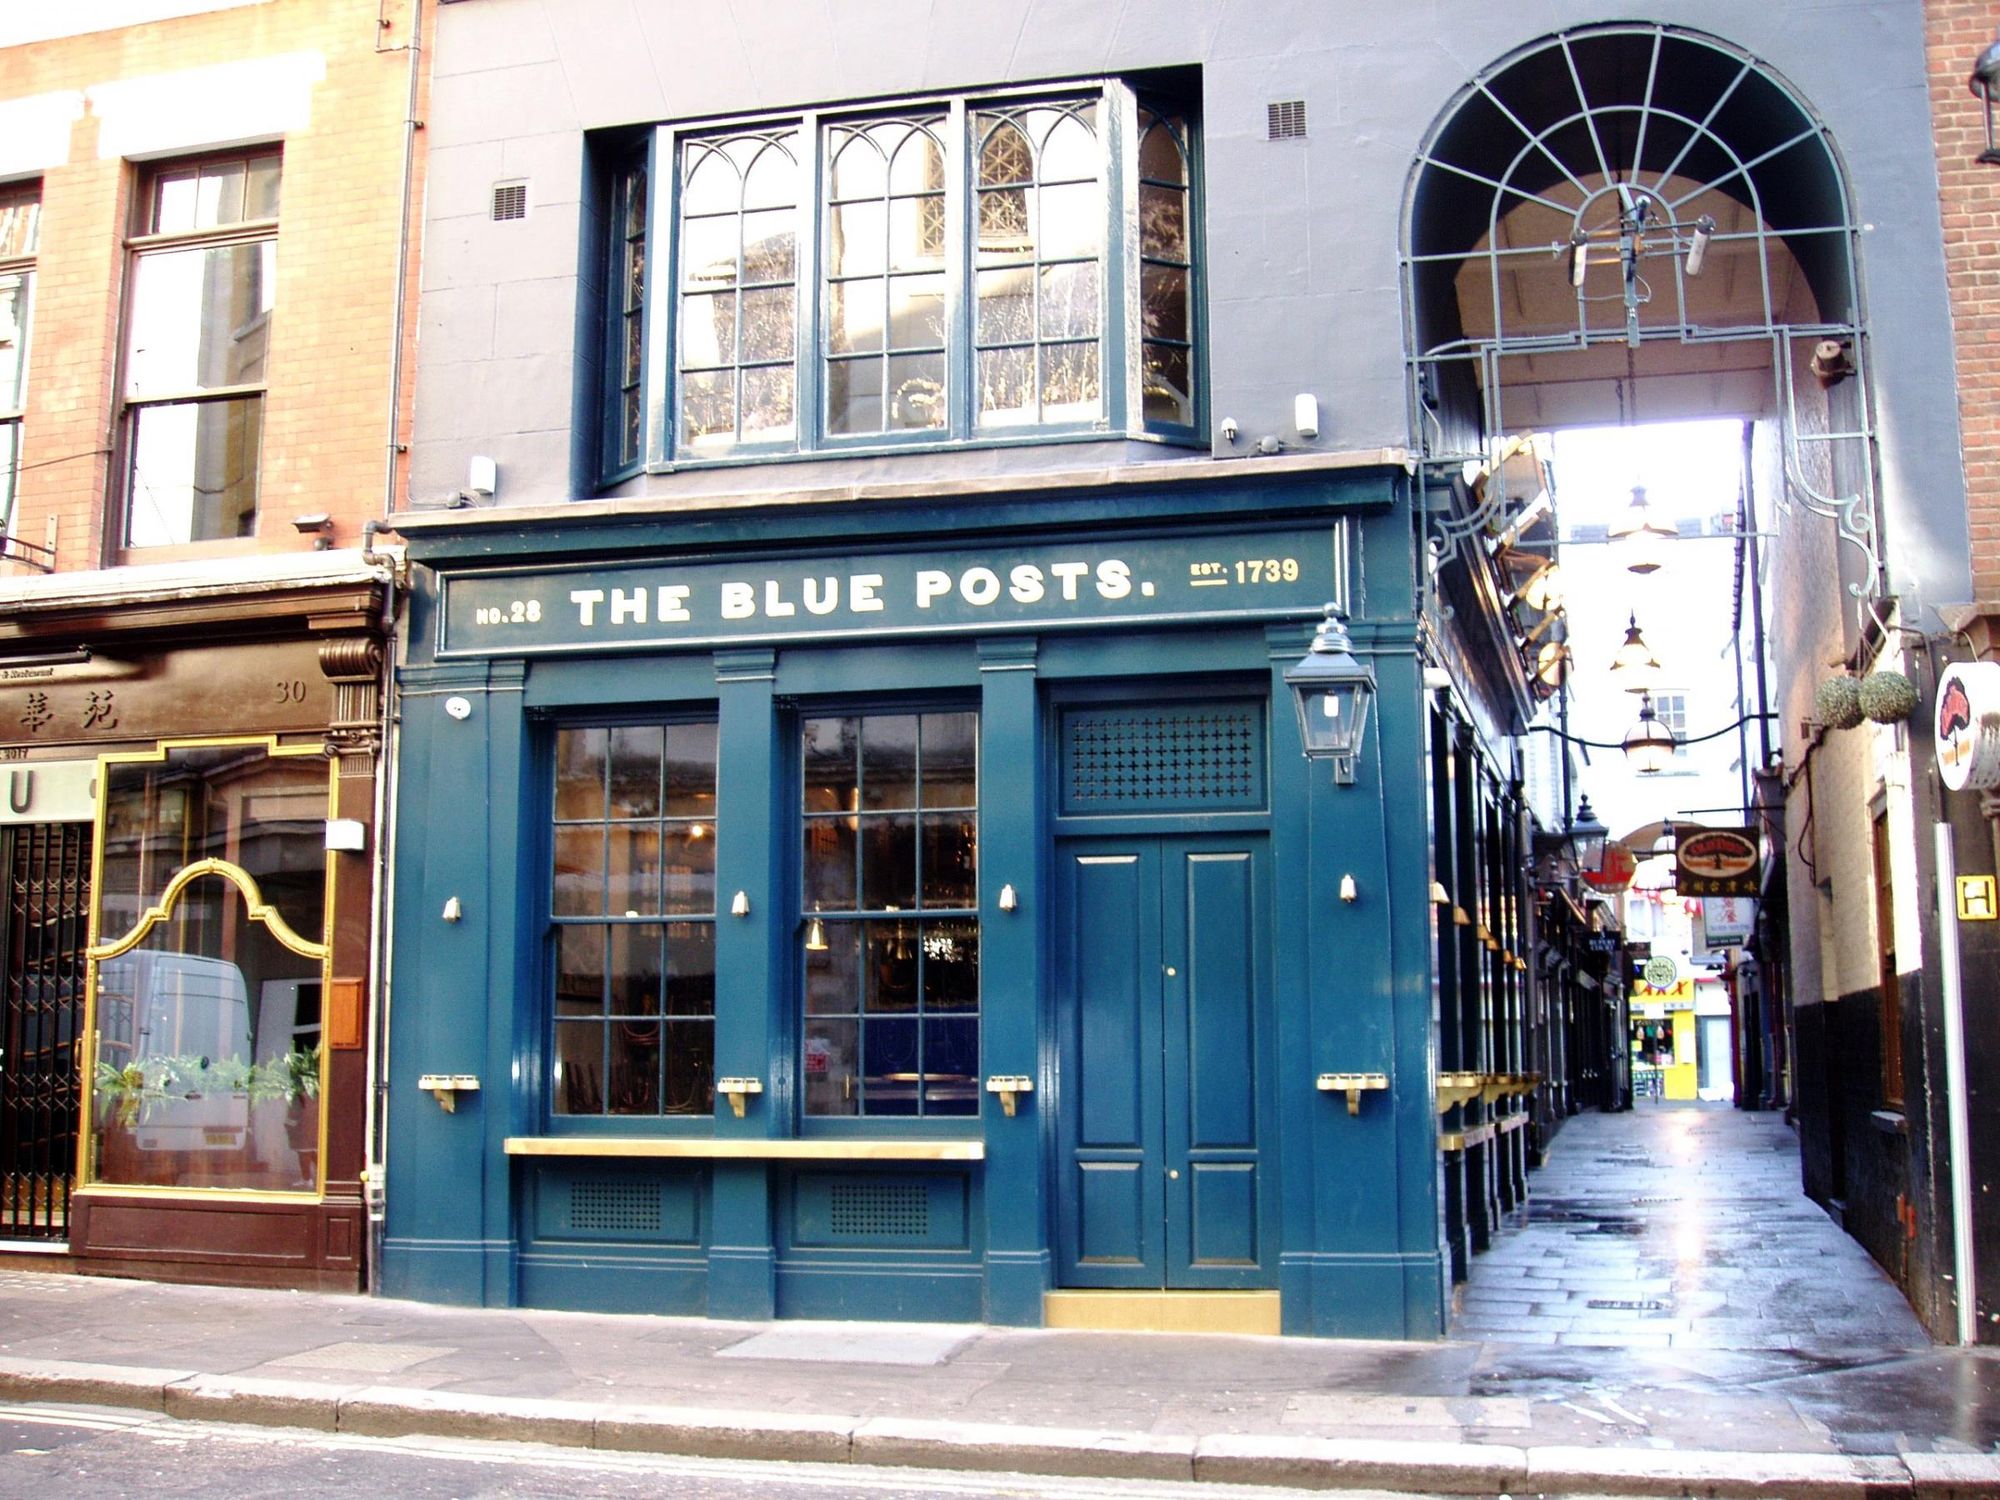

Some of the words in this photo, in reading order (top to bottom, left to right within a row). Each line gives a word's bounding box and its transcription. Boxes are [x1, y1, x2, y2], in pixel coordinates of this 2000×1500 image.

[570, 584, 692, 626] THE
[720, 573, 885, 620] BLUE
[915, 558, 1157, 609] POSTS.
[1234, 557, 1299, 585] 1739
[275, 680, 307, 704] 30
[1962, 880, 1991, 914] H
